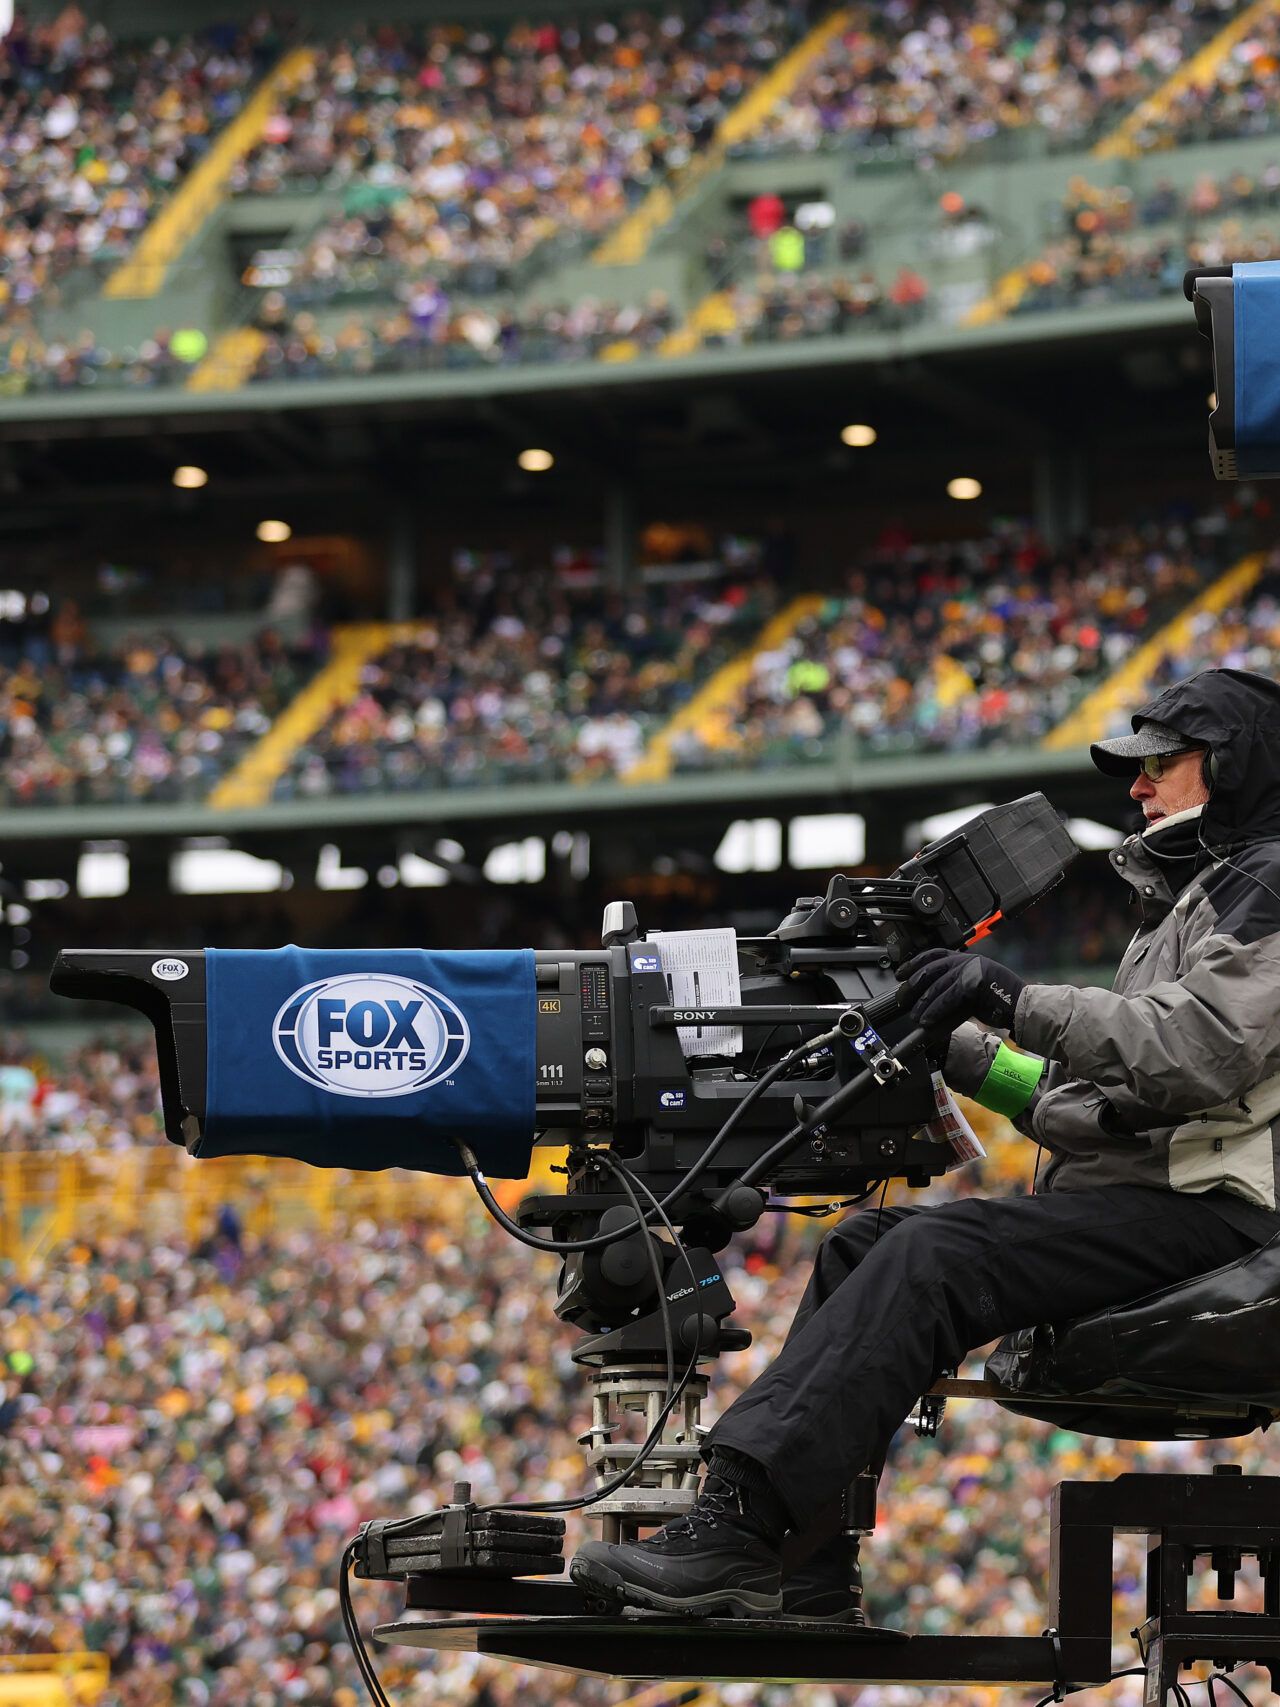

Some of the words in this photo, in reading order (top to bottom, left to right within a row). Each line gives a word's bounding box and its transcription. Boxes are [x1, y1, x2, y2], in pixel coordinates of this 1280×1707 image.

[162, 963, 179, 972] FOX
[541, 1001, 557, 1011] 4K
[673, 1011, 717, 1021] SONY
[316, 997, 426, 1050] FOX
[316, 1049, 427, 1071] SPORTS
[540, 1064, 564, 1078] 111
[666, 1286, 696, 1302] Vecto
[699, 1274, 721, 1288] 750
